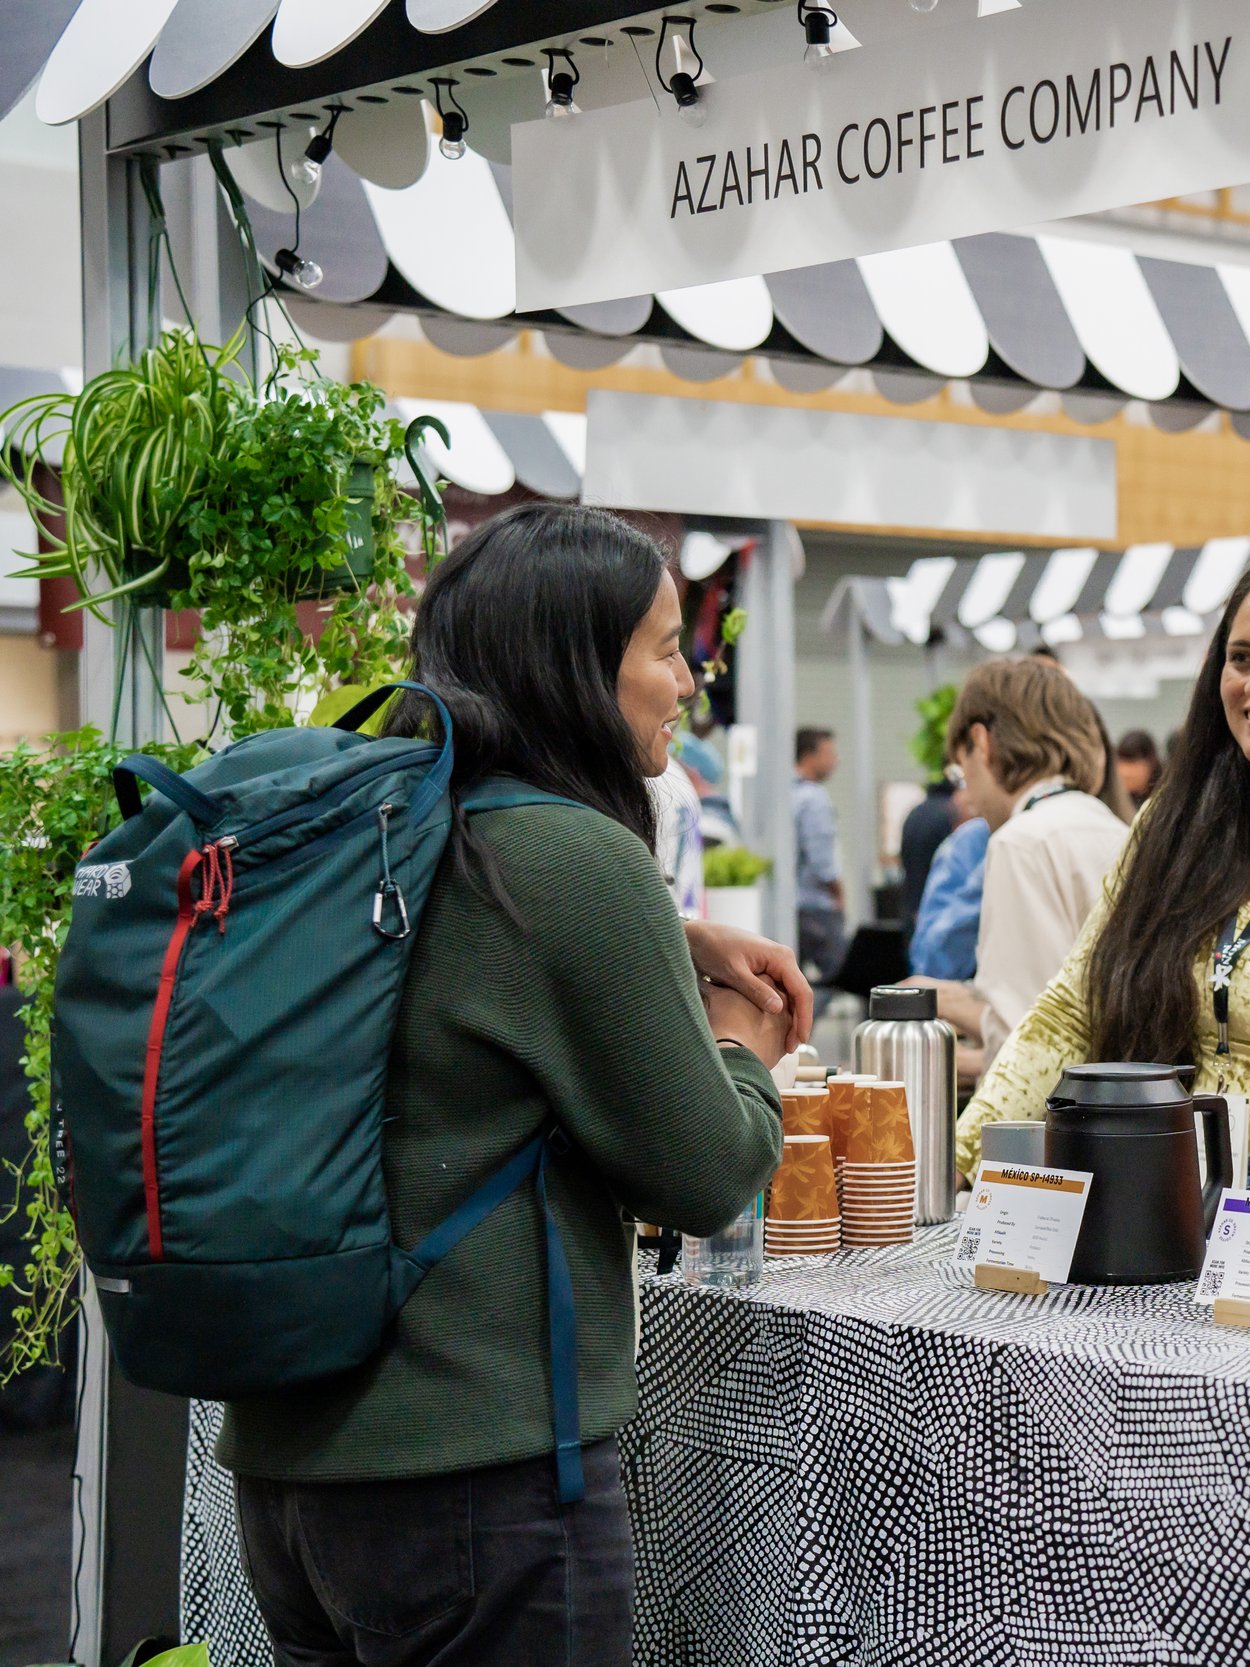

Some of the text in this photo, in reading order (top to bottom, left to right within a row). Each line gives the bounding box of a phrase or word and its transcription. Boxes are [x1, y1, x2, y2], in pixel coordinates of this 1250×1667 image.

[671, 36, 1232, 218] AZAHAR COFFEE COMPANY
[55, 1119, 65, 1158] TREE
[56, 1166, 66, 1184] 22
[1029, 1171, 1064, 1185] SP-14933
[979, 1195, 987, 1204] M
[1223, 1225, 1231, 1235] S
